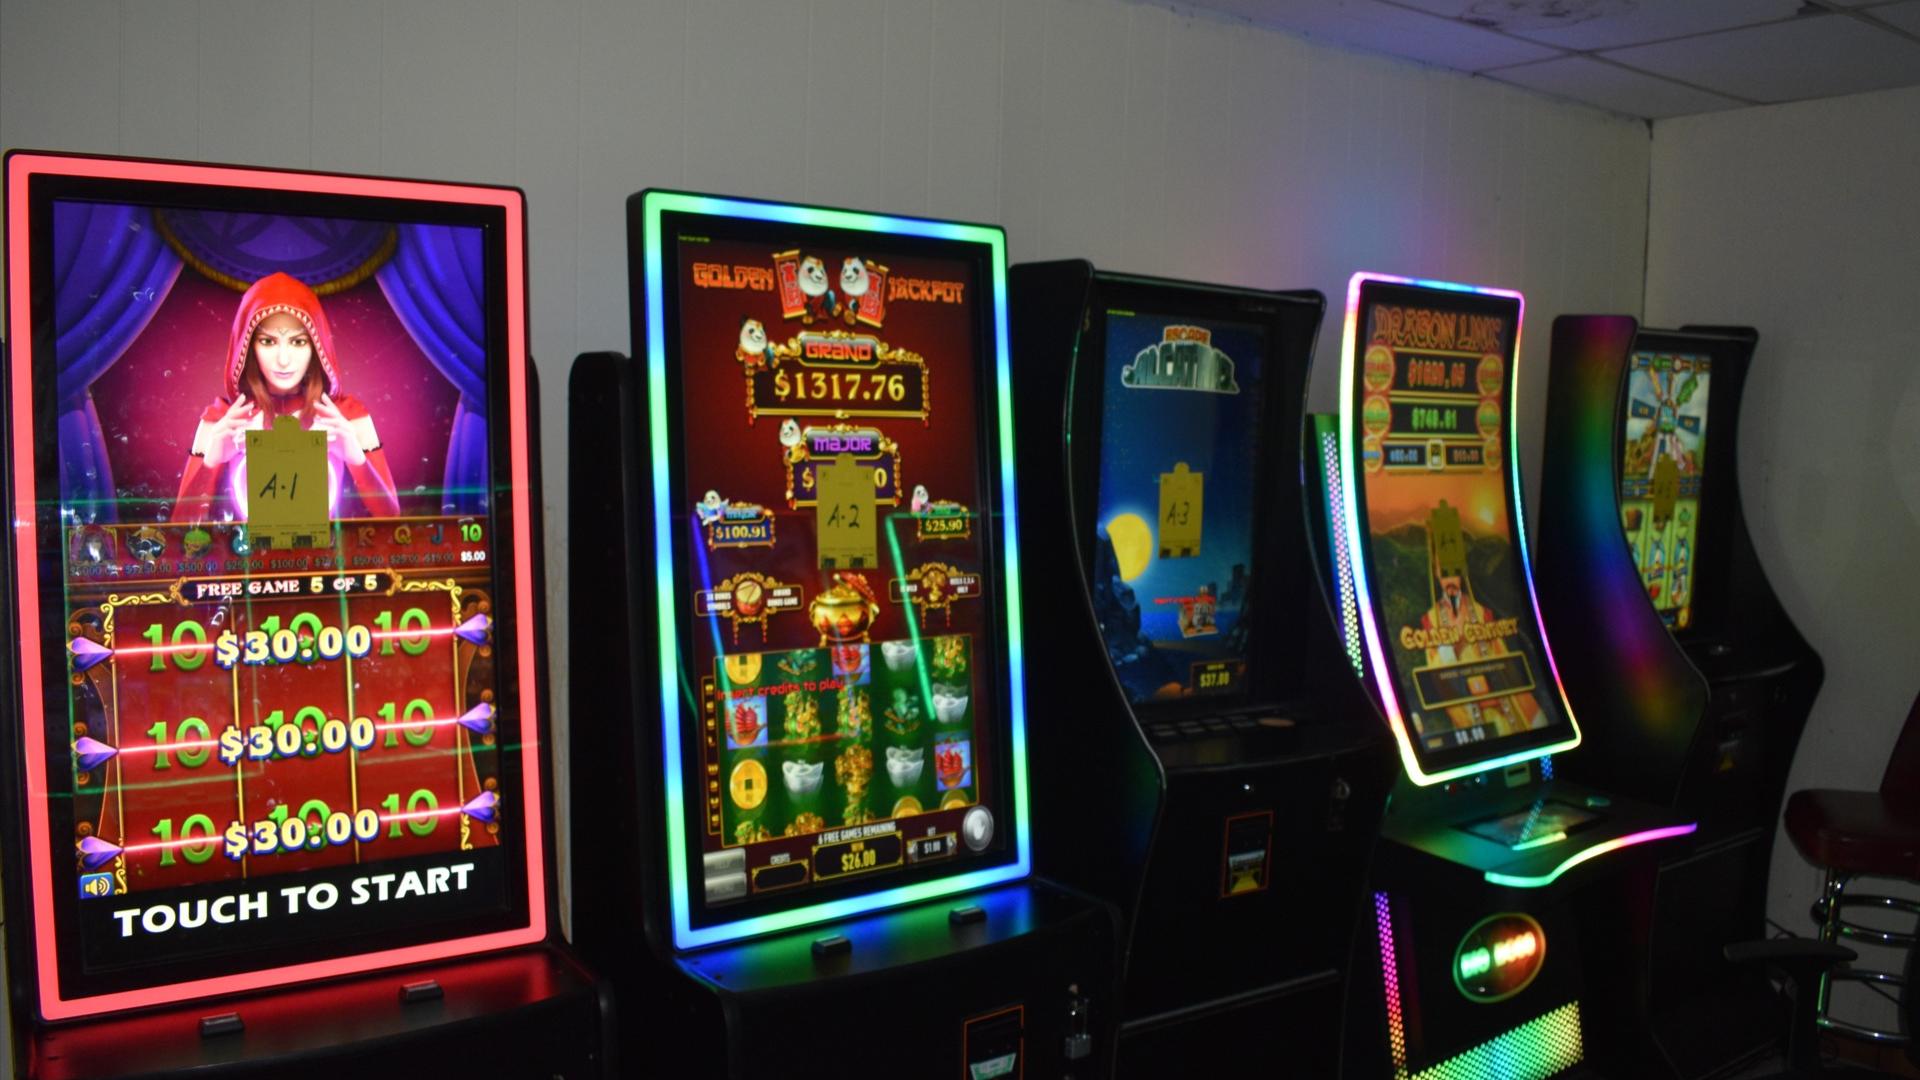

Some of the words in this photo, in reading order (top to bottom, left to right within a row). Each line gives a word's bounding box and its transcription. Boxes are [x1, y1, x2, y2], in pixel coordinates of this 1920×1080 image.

[693, 263, 774, 291] GOLDEN
[888, 276, 964, 305] JACKPOT
[1374, 304, 1457, 348] DRAGON
[806, 342, 872, 362] GRAND
[774, 369, 905, 401] $1317.76
[814, 437, 871, 451] MAJOR
[461, 523, 482, 542] 10
[716, 525, 767, 539] $100.91
[925, 519, 963, 532] $25.90
[461, 551, 486, 562] $5.00
[196, 582, 243, 598] FREE
[248, 579, 300, 595] GAME
[311, 577, 323, 593] 5
[333, 577, 355, 592] OF
[364, 574, 378, 590] 5
[143, 620, 207, 671] 10
[216, 625, 372, 669] $30.00
[374, 607, 431, 655] 10
[716, 687, 755, 700] Inert
[758, 682, 801, 696] credits
[804, 681, 817, 691] to
[148, 717, 211, 769] 10
[219, 717, 375, 767] $30.00
[377, 699, 434, 747] 10
[224, 809, 380, 861] $30.00
[381, 789, 439, 838] 10
[152, 813, 216, 866] 10
[842, 848, 876, 872] $26.00
[113, 891, 268, 937] TOUCH
[281, 883, 338, 914] TO
[351, 863, 474, 905] START
